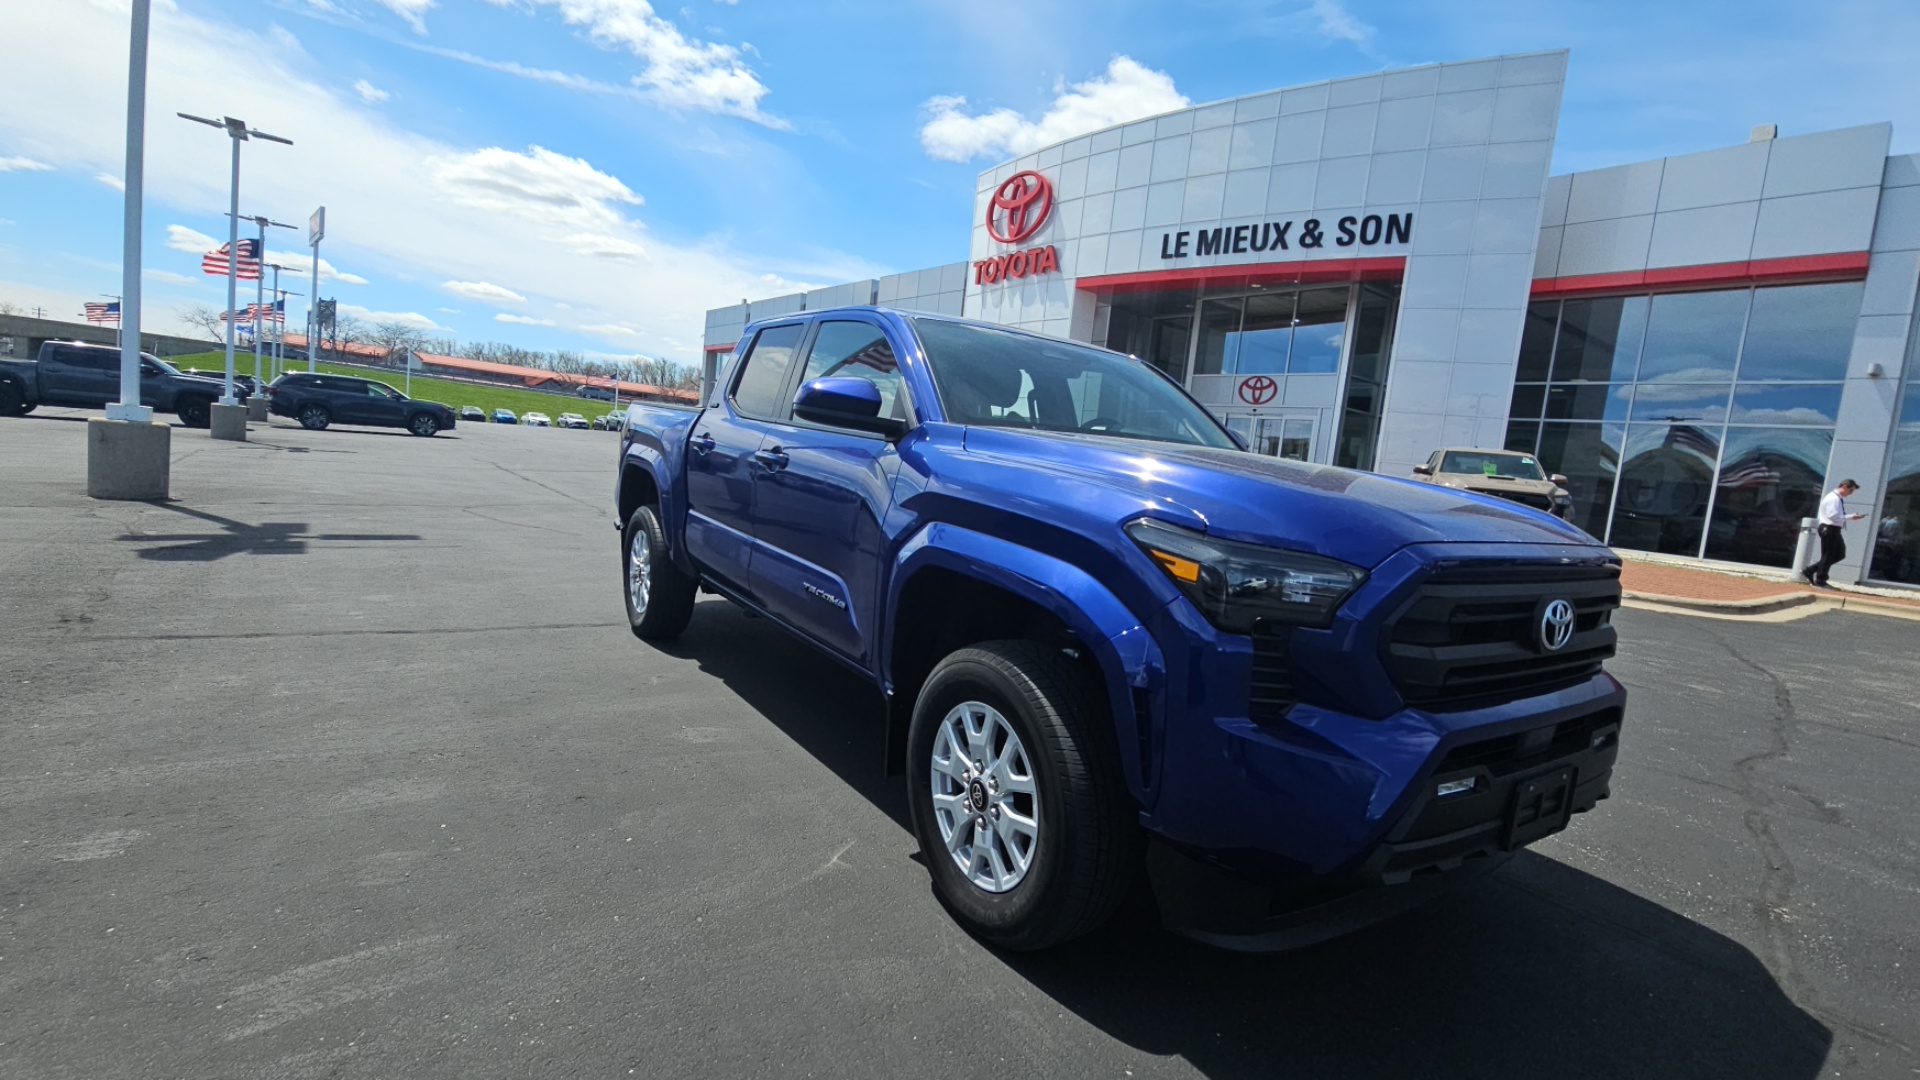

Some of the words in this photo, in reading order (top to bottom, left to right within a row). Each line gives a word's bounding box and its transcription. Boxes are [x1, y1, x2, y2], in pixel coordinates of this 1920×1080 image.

[1161, 231, 1189, 260] LE
[1196, 221, 1291, 256] MIEUX
[1299, 218, 1324, 249] &
[1336, 213, 1413, 247] SON
[973, 245, 1058, 286] TOYOTA
